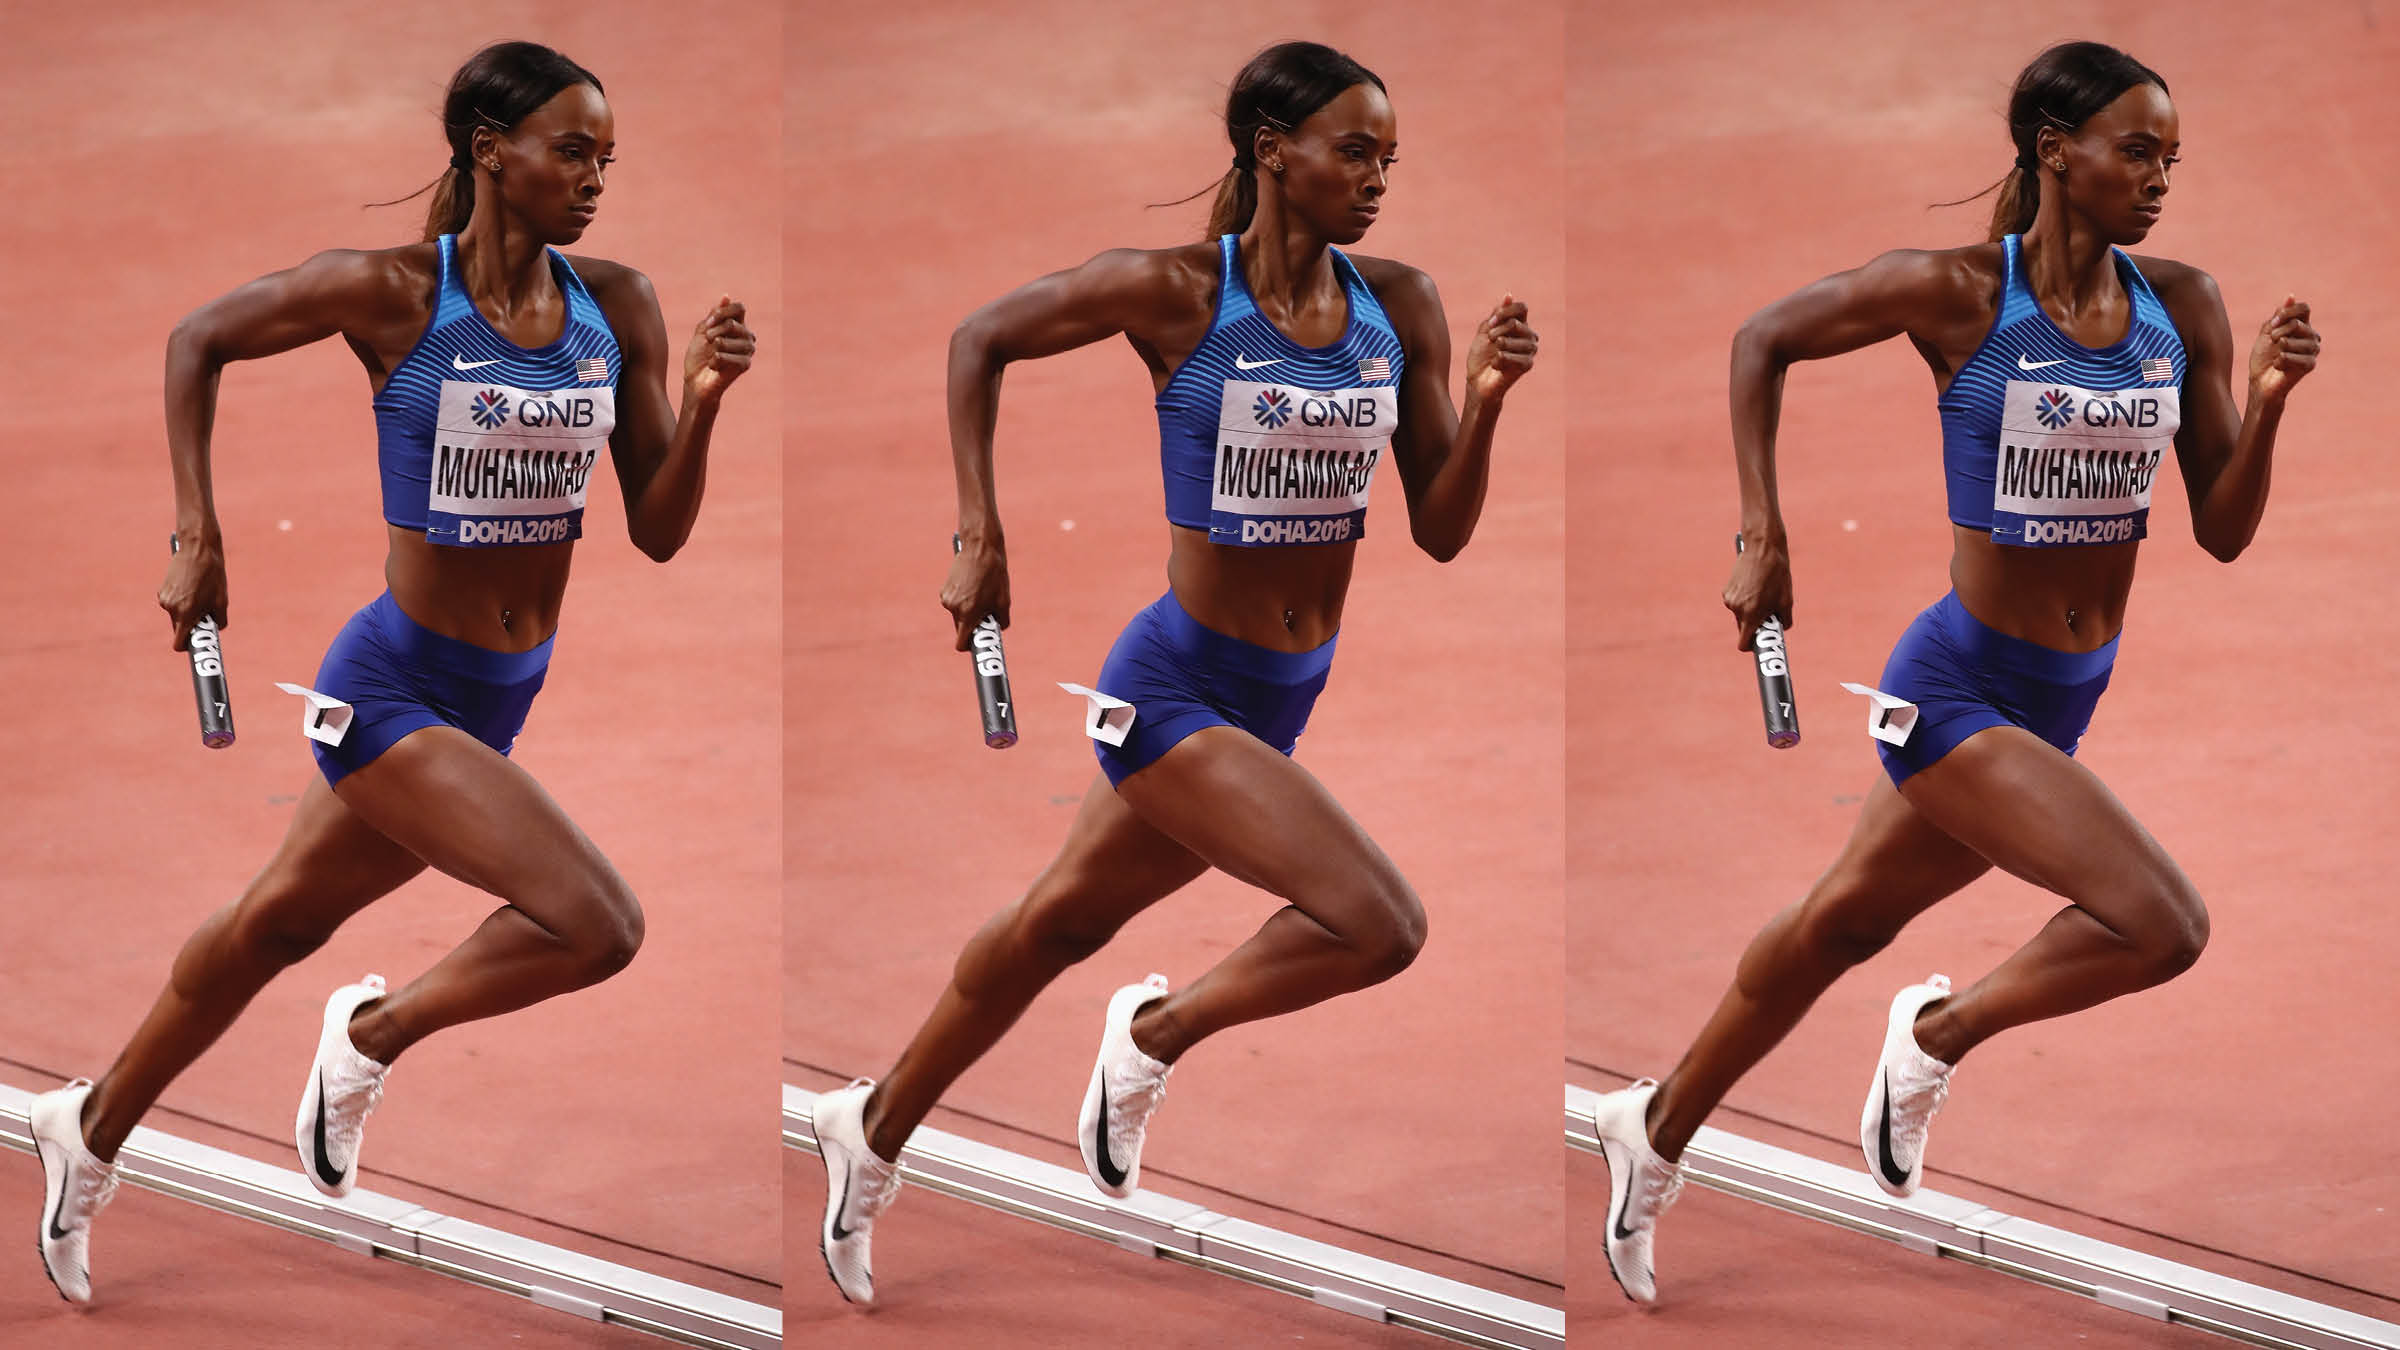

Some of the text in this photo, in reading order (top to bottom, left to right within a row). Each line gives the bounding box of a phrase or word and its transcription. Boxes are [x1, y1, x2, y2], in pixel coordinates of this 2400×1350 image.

[518, 398, 594, 428] QNB
[1300, 398, 1376, 428] QNB
[2083, 398, 2159, 428] QNB
[437, 445, 596, 499] MUHAMMAD
[1220, 445, 1378, 499] MUHAMMAD
[2002, 445, 2161, 499] MUHAMMAD
[459, 517, 568, 544] DOHA2019
[1242, 517, 1350, 544] DOHA2019
[2024, 517, 2133, 544] DOHA2019
[214, 702, 226, 718] 7
[996, 702, 1008, 718] 7
[1779, 702, 1791, 718] 7
